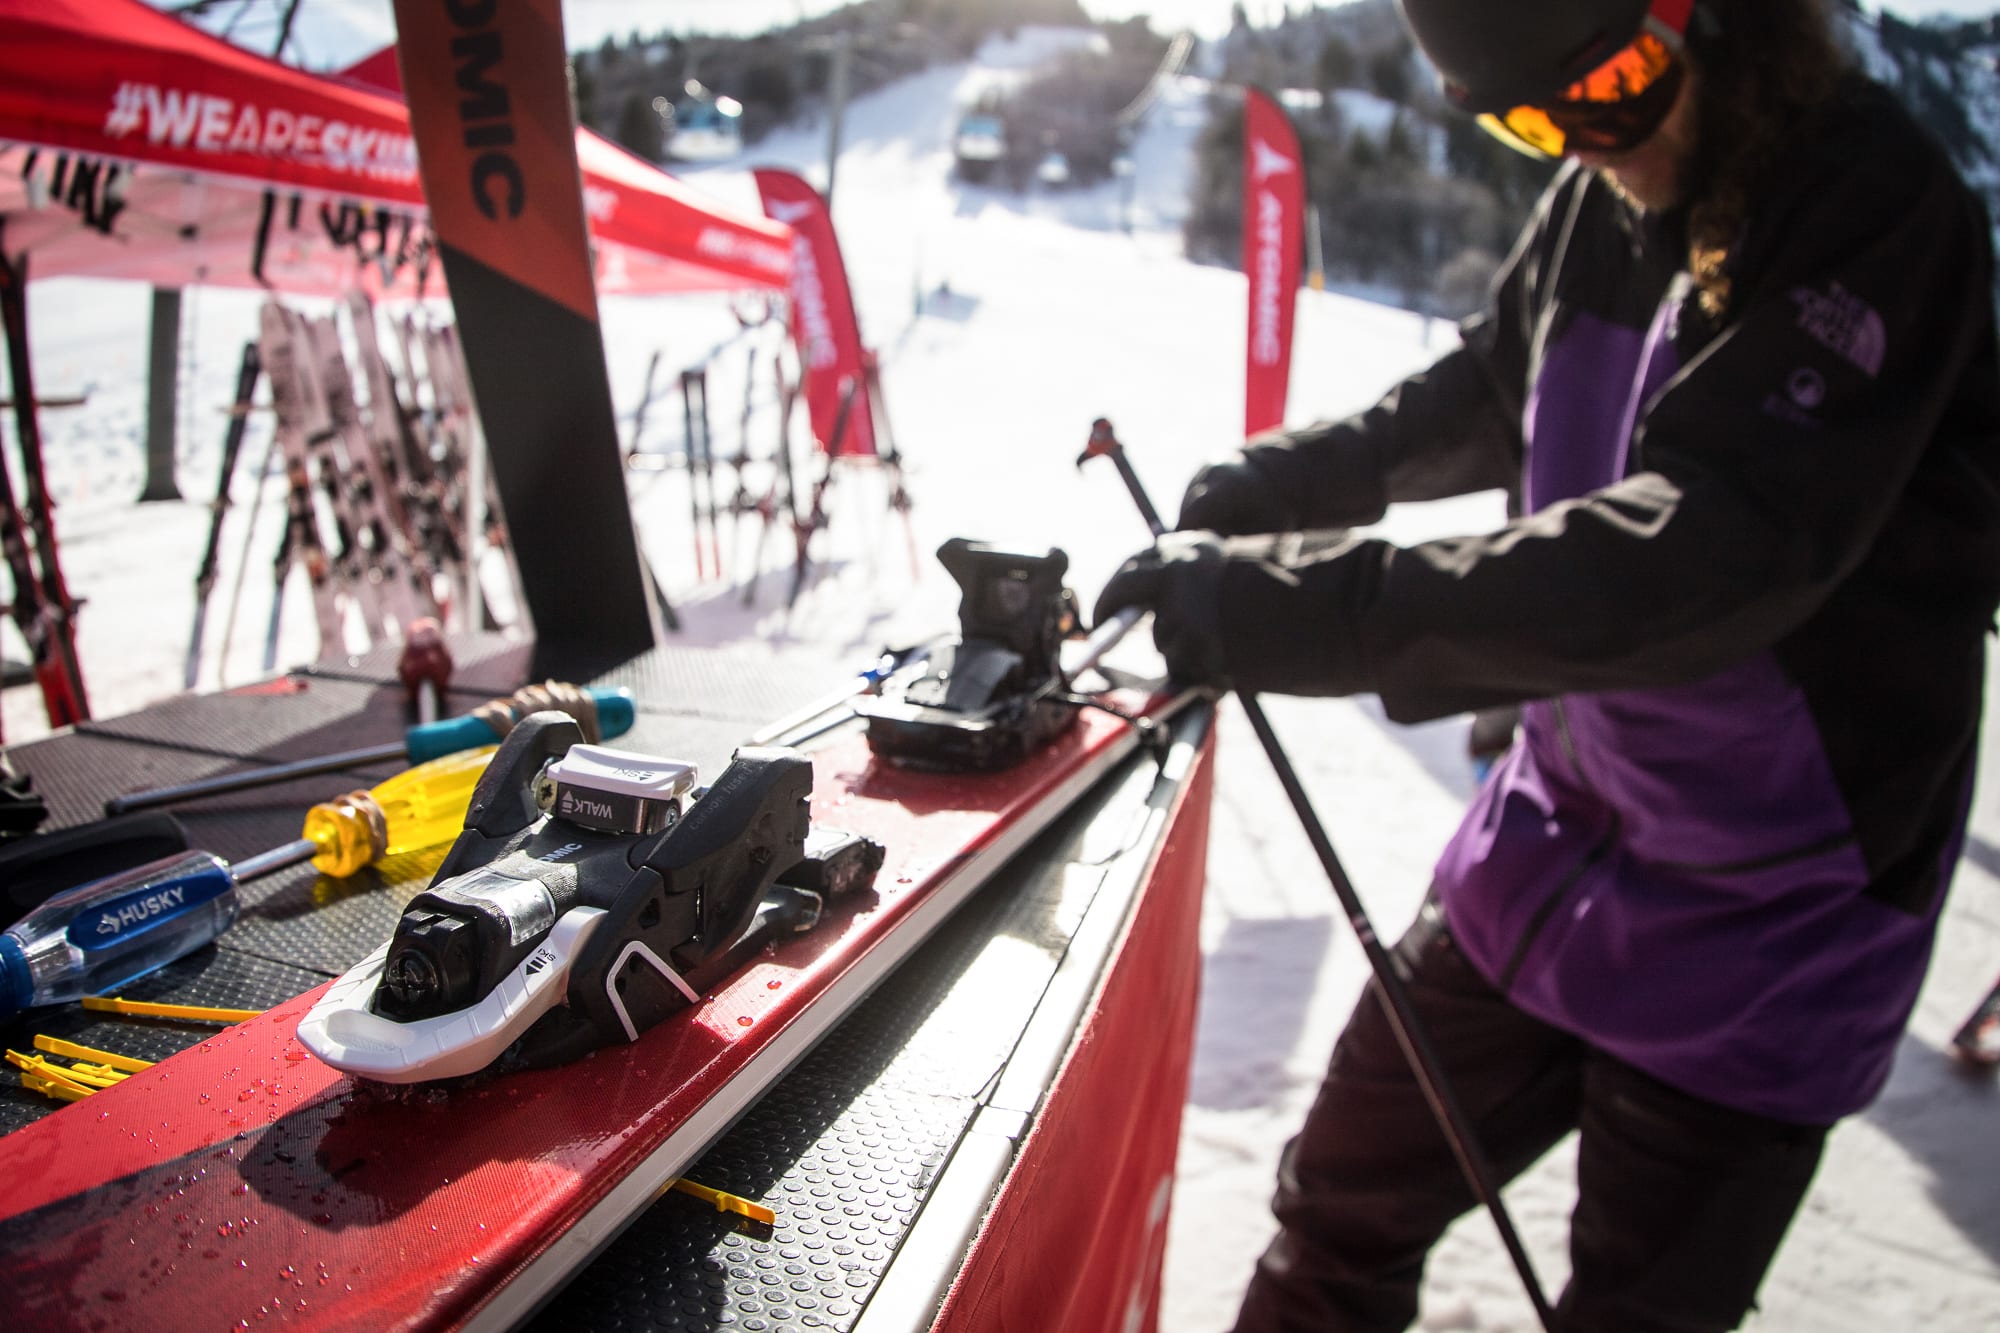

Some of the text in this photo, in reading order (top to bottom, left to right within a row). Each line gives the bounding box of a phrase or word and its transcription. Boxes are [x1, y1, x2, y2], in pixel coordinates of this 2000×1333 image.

[574, 799, 613, 819] WALK
[118, 886, 184, 926] HUSKY
[537, 948, 557, 962] SKI
